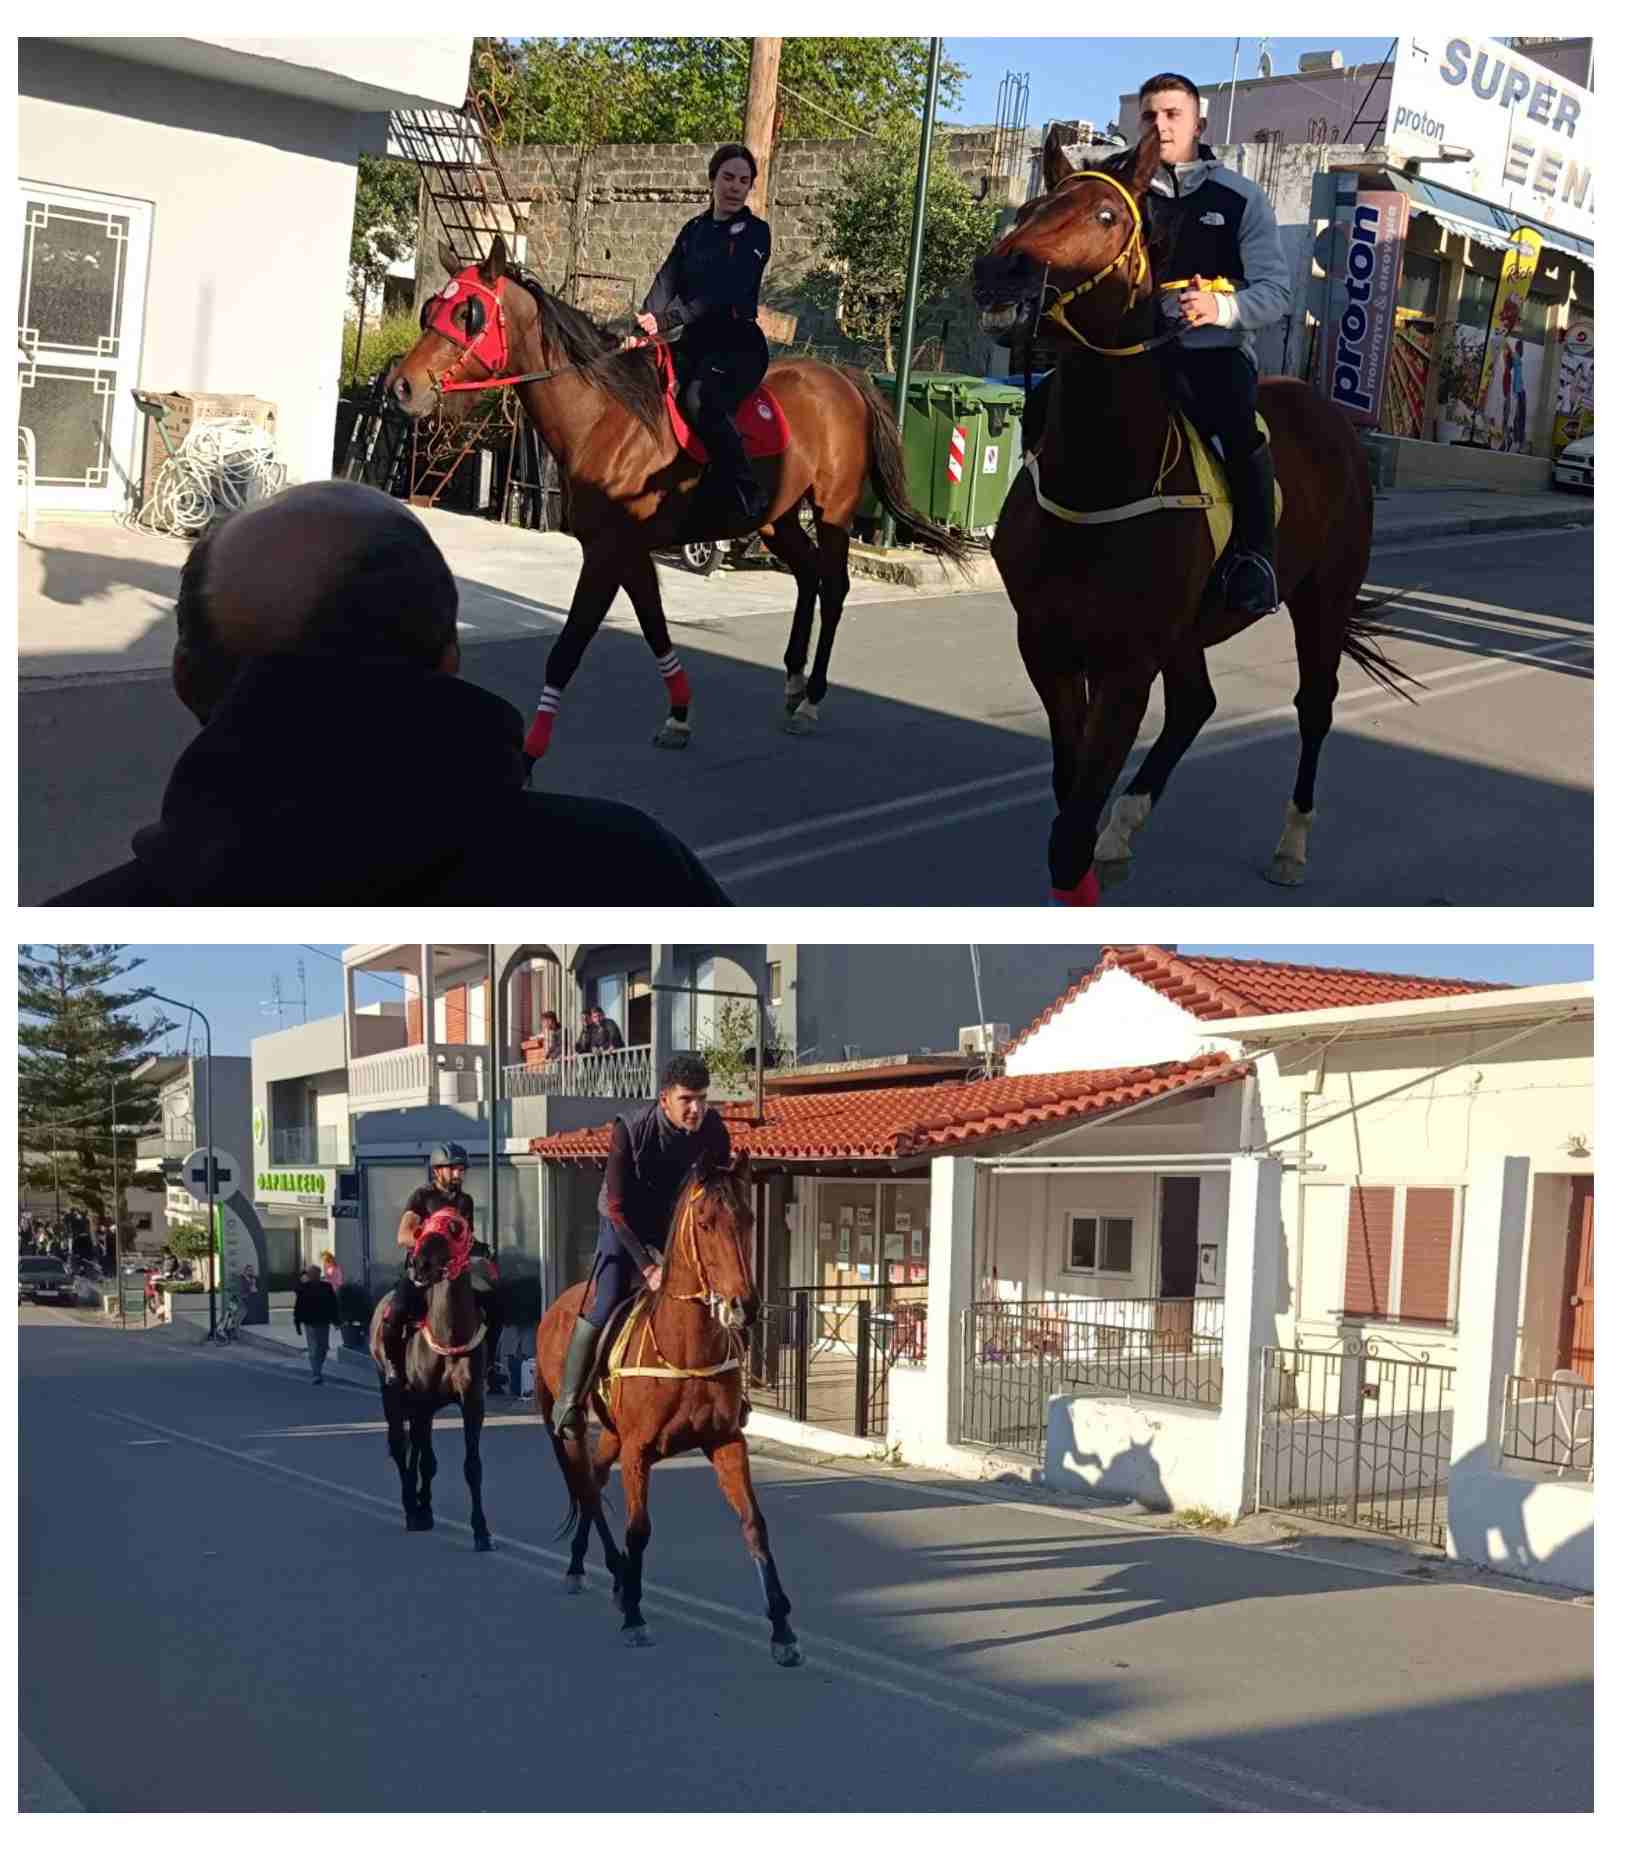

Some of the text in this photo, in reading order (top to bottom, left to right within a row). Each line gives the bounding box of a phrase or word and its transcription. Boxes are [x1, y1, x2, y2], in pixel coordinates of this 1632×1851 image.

[1392, 104, 1446, 141] proton
[1440, 38, 1582, 139] SUPER
[1331, 204, 1381, 412] proton
